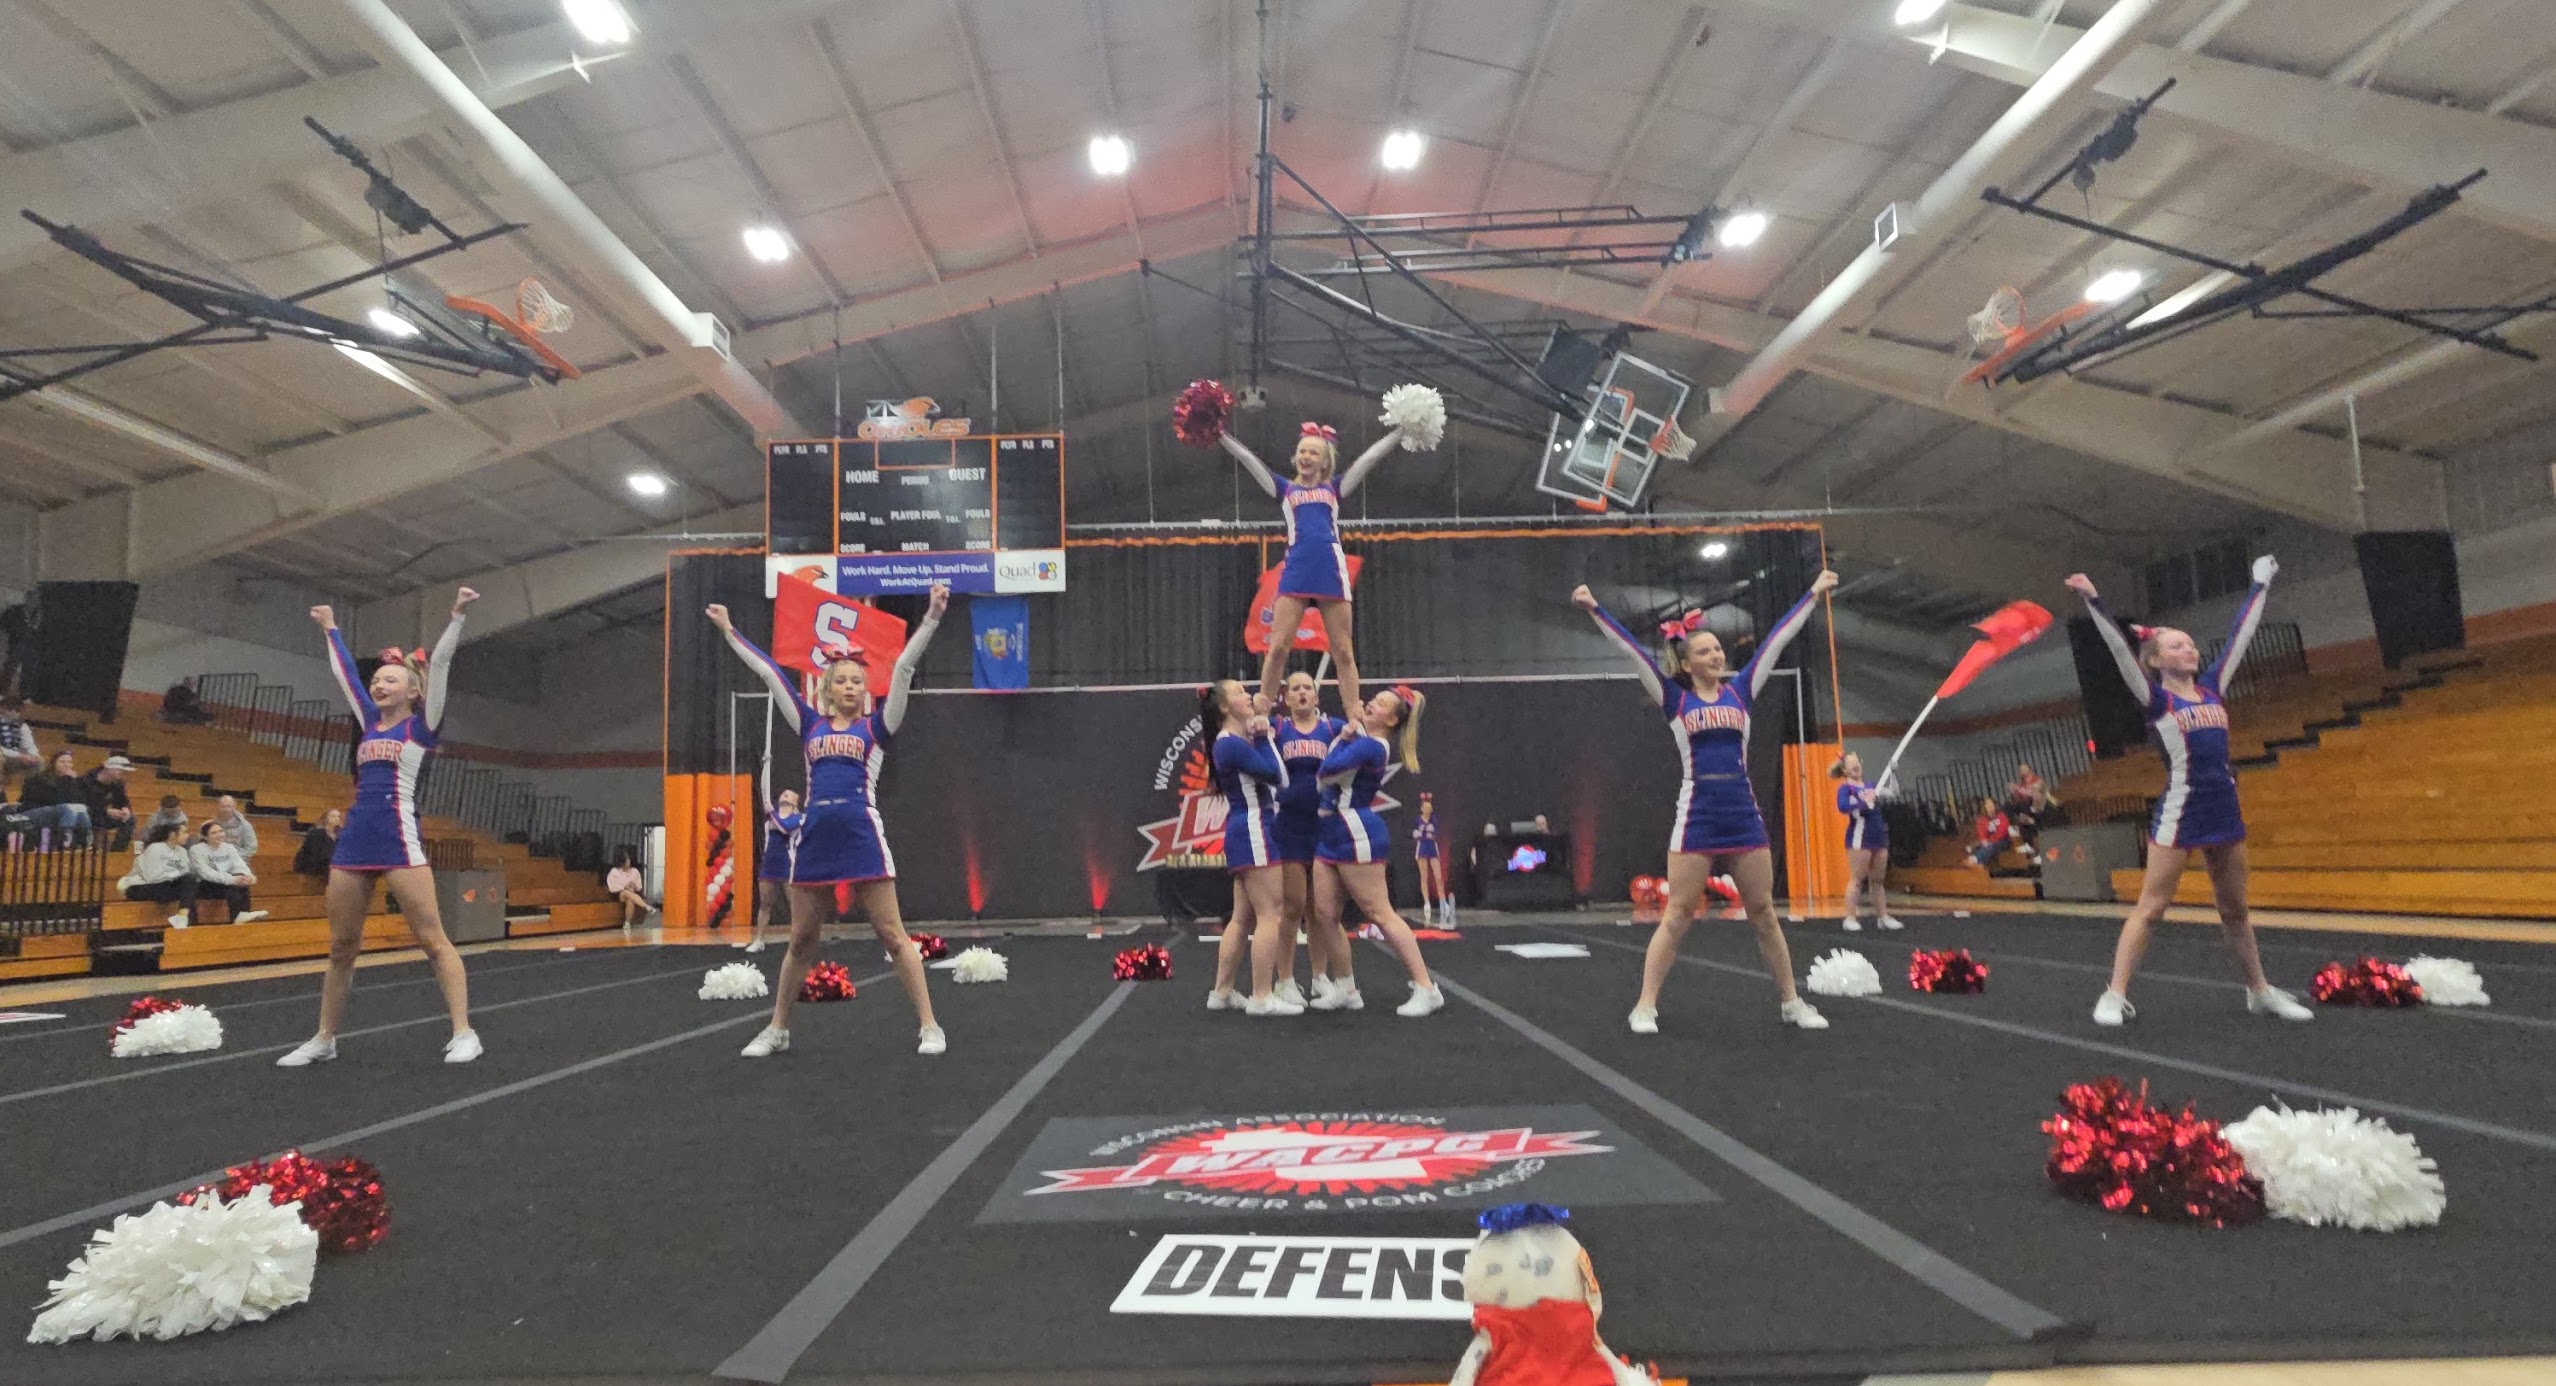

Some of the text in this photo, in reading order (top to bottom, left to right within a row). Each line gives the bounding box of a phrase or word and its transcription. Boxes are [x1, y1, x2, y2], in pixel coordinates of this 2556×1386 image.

[846, 470, 880, 484] HOME
[901, 475, 930, 485] PERIOD
[949, 467, 986, 481] GUEST
[840, 511, 866, 522] FOULS
[890, 510, 941, 520] PLAYER FOUL
[965, 508, 991, 519] FOULS
[840, 543, 865, 553] SCORE
[901, 541, 930, 551] MATCH
[965, 540, 991, 550] SCORE
[842, 563, 990, 576] Work Hard. Move Up. Stand Proud.
[999, 562, 1037, 581] Quad
[1684, 705, 1745, 734] SLINGER
[808, 734, 866, 761] SLINGER
[1154, 713, 1203, 790] WISCONS
[1283, 739, 1328, 762] SLINGER
[1163, 1190, 1289, 1210] CHEER
[1344, 1191, 1438, 1209] POM
[1142, 1244, 1466, 1301] DEFENS
